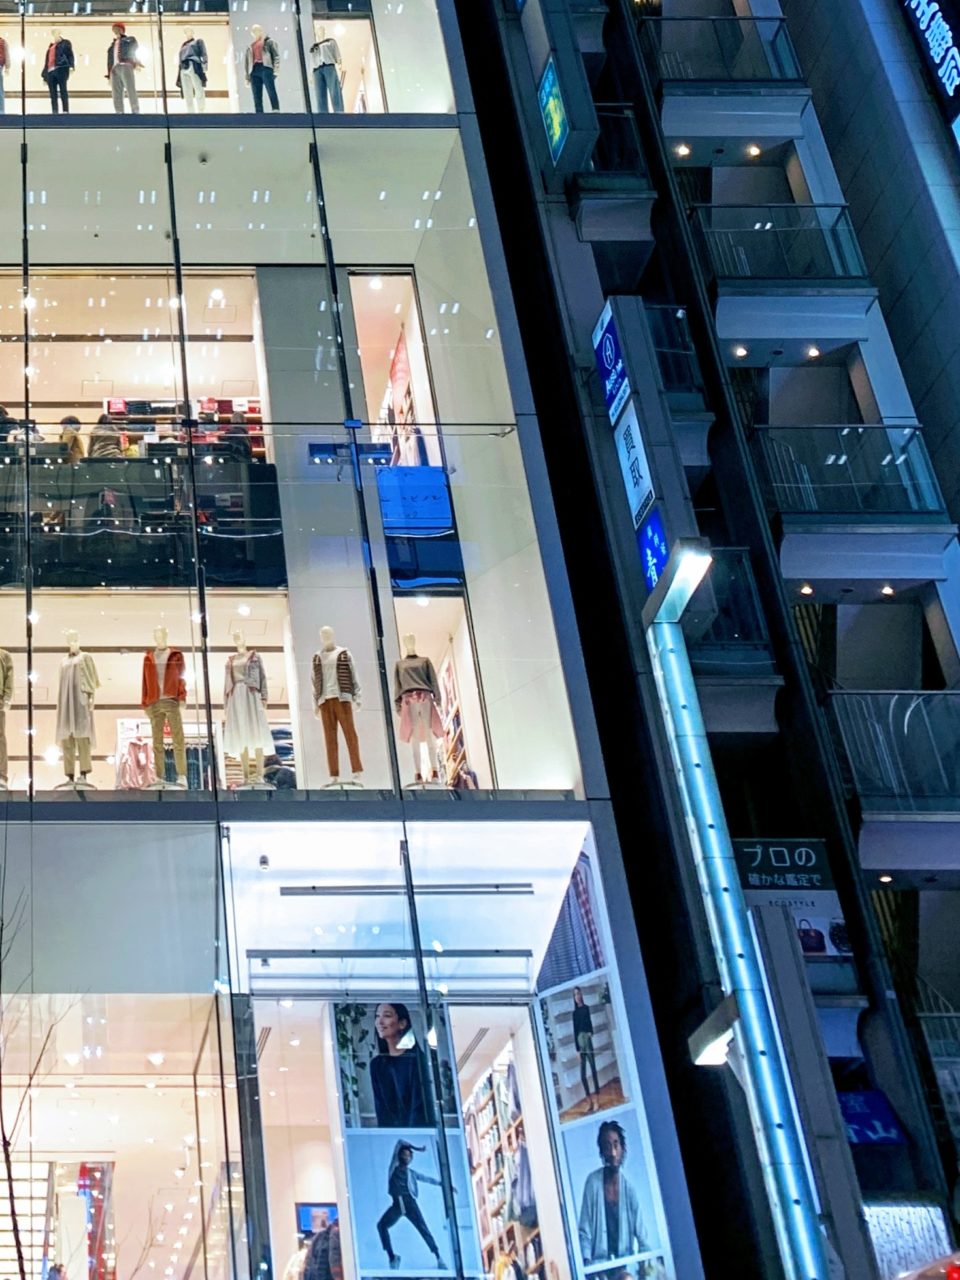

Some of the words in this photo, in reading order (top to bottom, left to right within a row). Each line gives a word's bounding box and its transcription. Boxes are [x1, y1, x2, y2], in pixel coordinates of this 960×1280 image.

[623, 424, 644, 489] 買取
[743, 844, 816, 867] プロの
[748, 872, 822, 887] 確かな鑑定で
